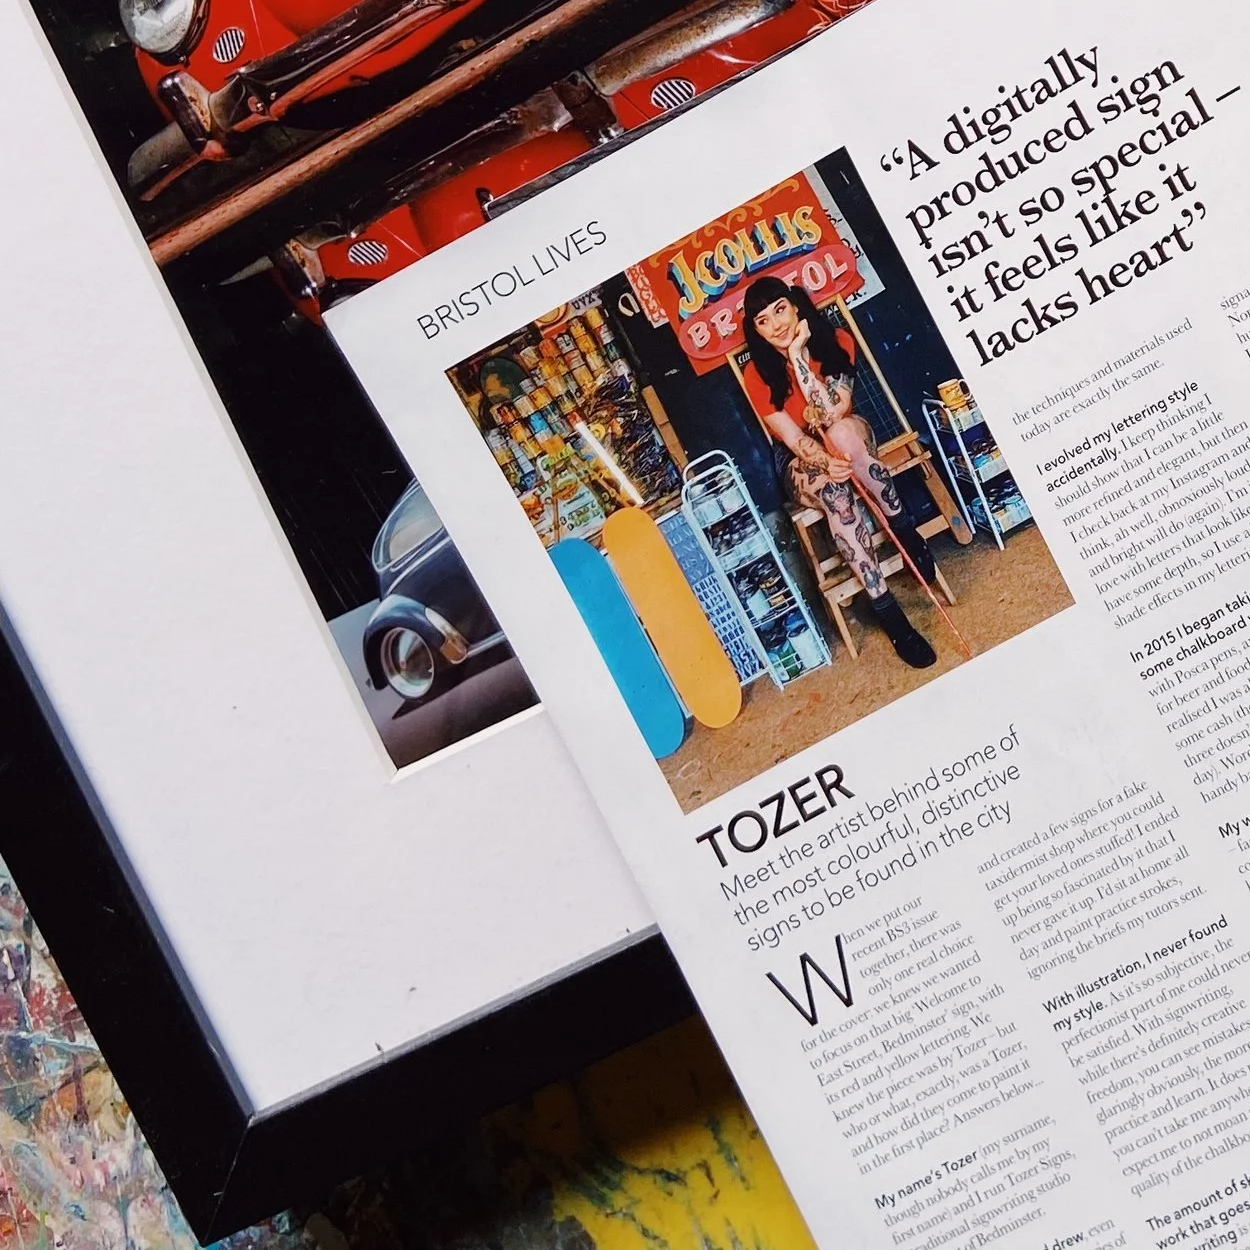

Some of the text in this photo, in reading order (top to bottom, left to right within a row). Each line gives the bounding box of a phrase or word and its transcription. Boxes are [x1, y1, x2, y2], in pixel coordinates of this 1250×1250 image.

[905, 60, 1185, 246] produced sign
[943, 46, 1100, 155] digitally
[1019, 186, 1065, 227] so
[1071, 87, 1214, 197] special
[417, 221, 607, 340] BRISTOL LIVES
[947, 163, 1197, 322] it feels like it
[966, 291, 1079, 367] lacks
[1035, 382, 1198, 477] I evolved my lettering style
[1129, 650, 1145, 664] In
[1144, 631, 1176, 656] 2015
[1175, 626, 1184, 640] I
[1182, 609, 1225, 636] began
[695, 764, 855, 868] TOZER
[720, 722, 1021, 901] Meet the artist behind some of
[734, 765, 1020, 925] the most colourful, distinctive
[1217, 821, 1241, 839] My
[748, 801, 1011, 951] signs to be found in the city
[1042, 914, 1228, 1013] With illustration, I never found
